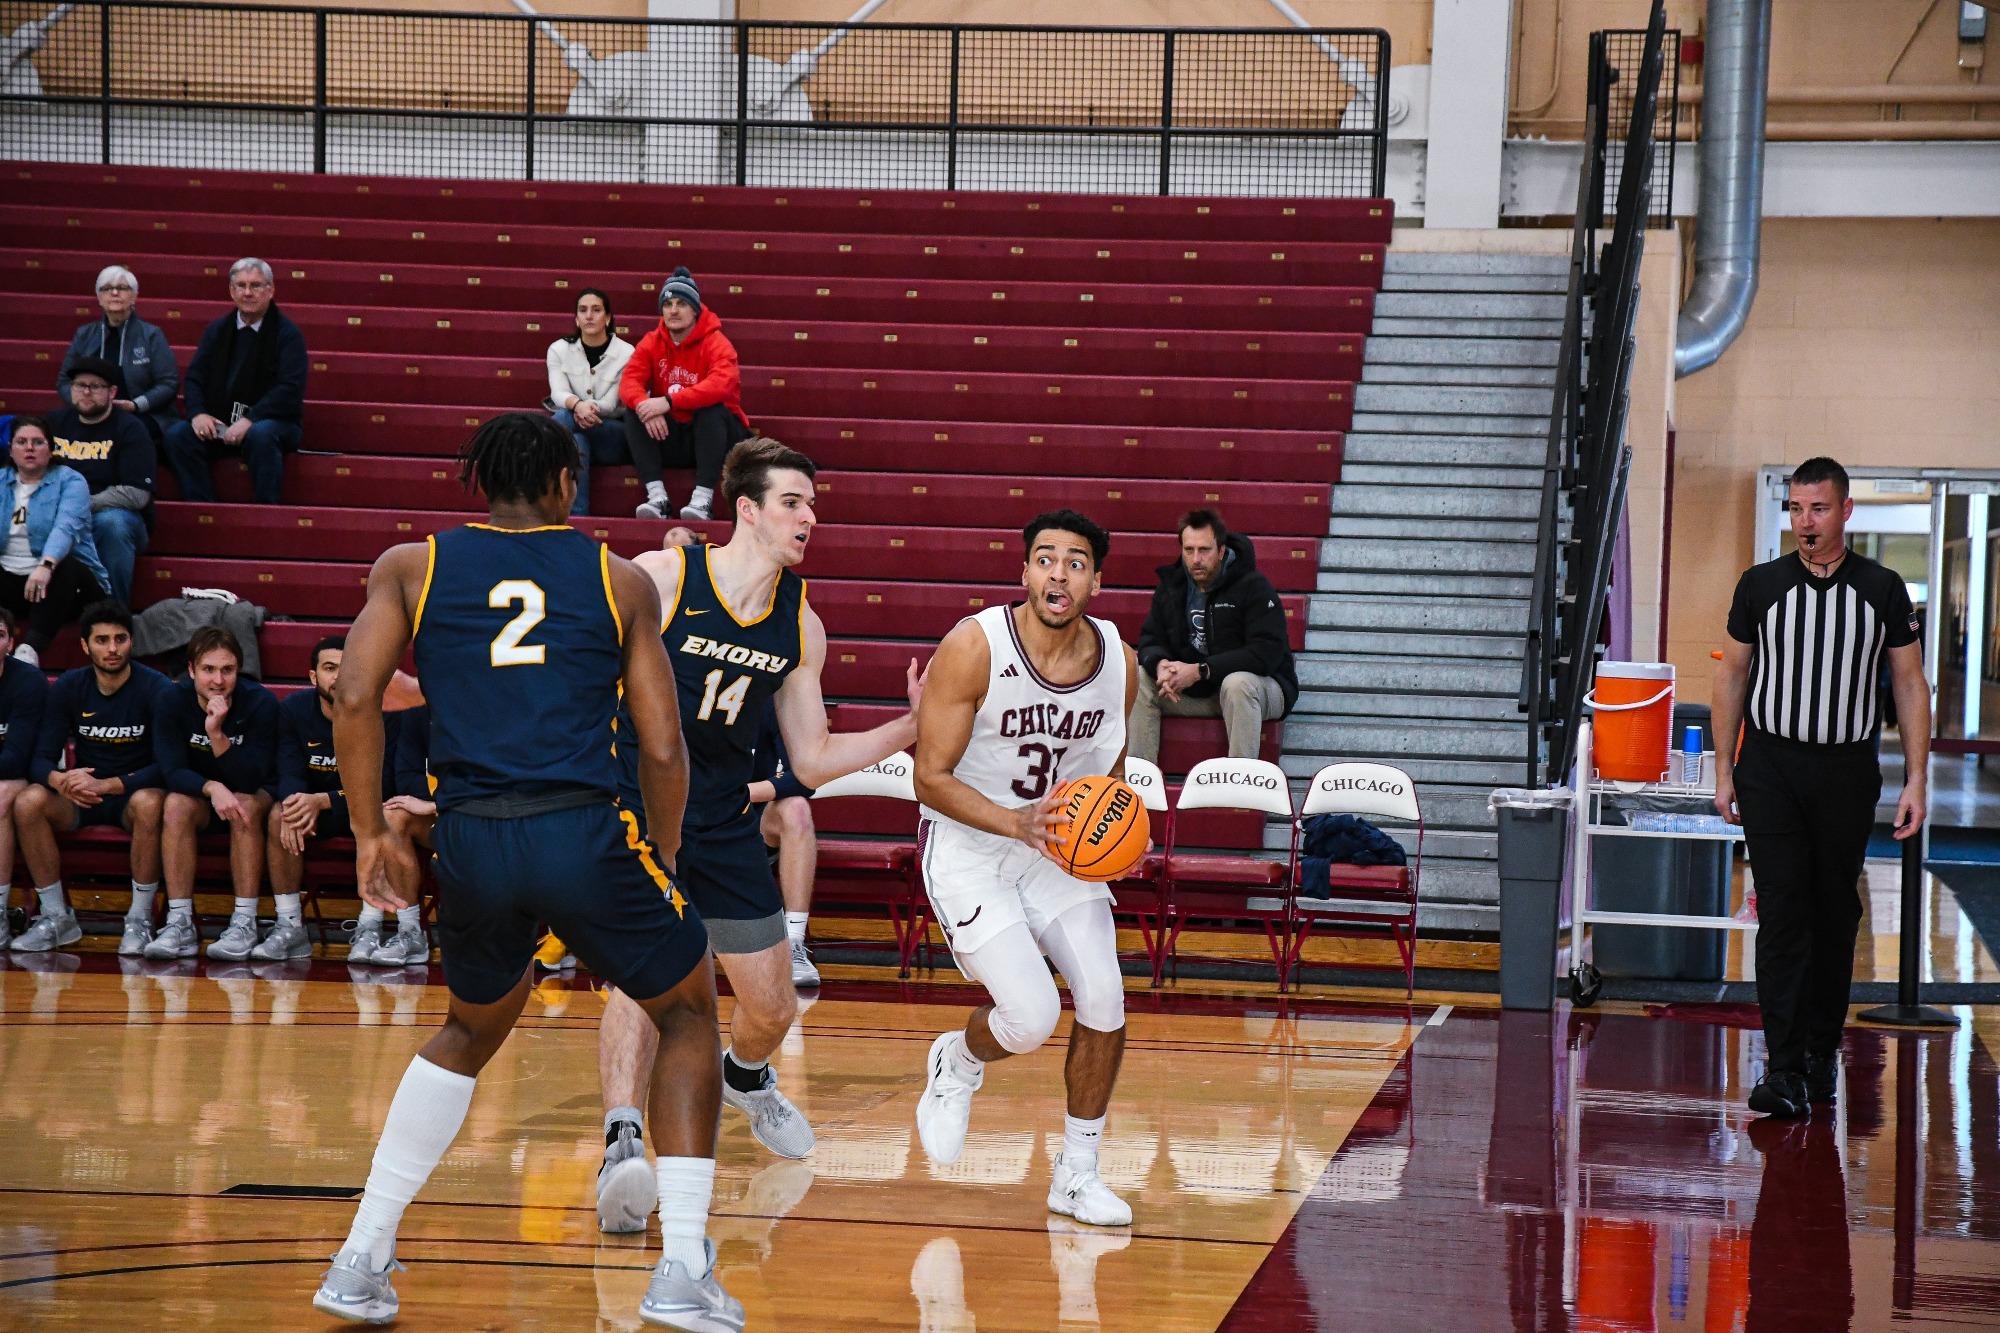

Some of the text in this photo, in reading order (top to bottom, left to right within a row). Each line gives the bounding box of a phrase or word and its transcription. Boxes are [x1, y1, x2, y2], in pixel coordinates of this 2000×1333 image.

[52, 436, 113, 460] EMORY
[488, 579, 546, 667] 2
[680, 634, 789, 674] EMORY
[697, 668, 753, 726] 14
[78, 724, 145, 739] EMORY
[1000, 703, 1106, 740] CHICAGO
[1196, 772, 1278, 790] CHICAGO
[1321, 778, 1404, 796] CHICAGO
[1087, 788, 1133, 846] Wilson
